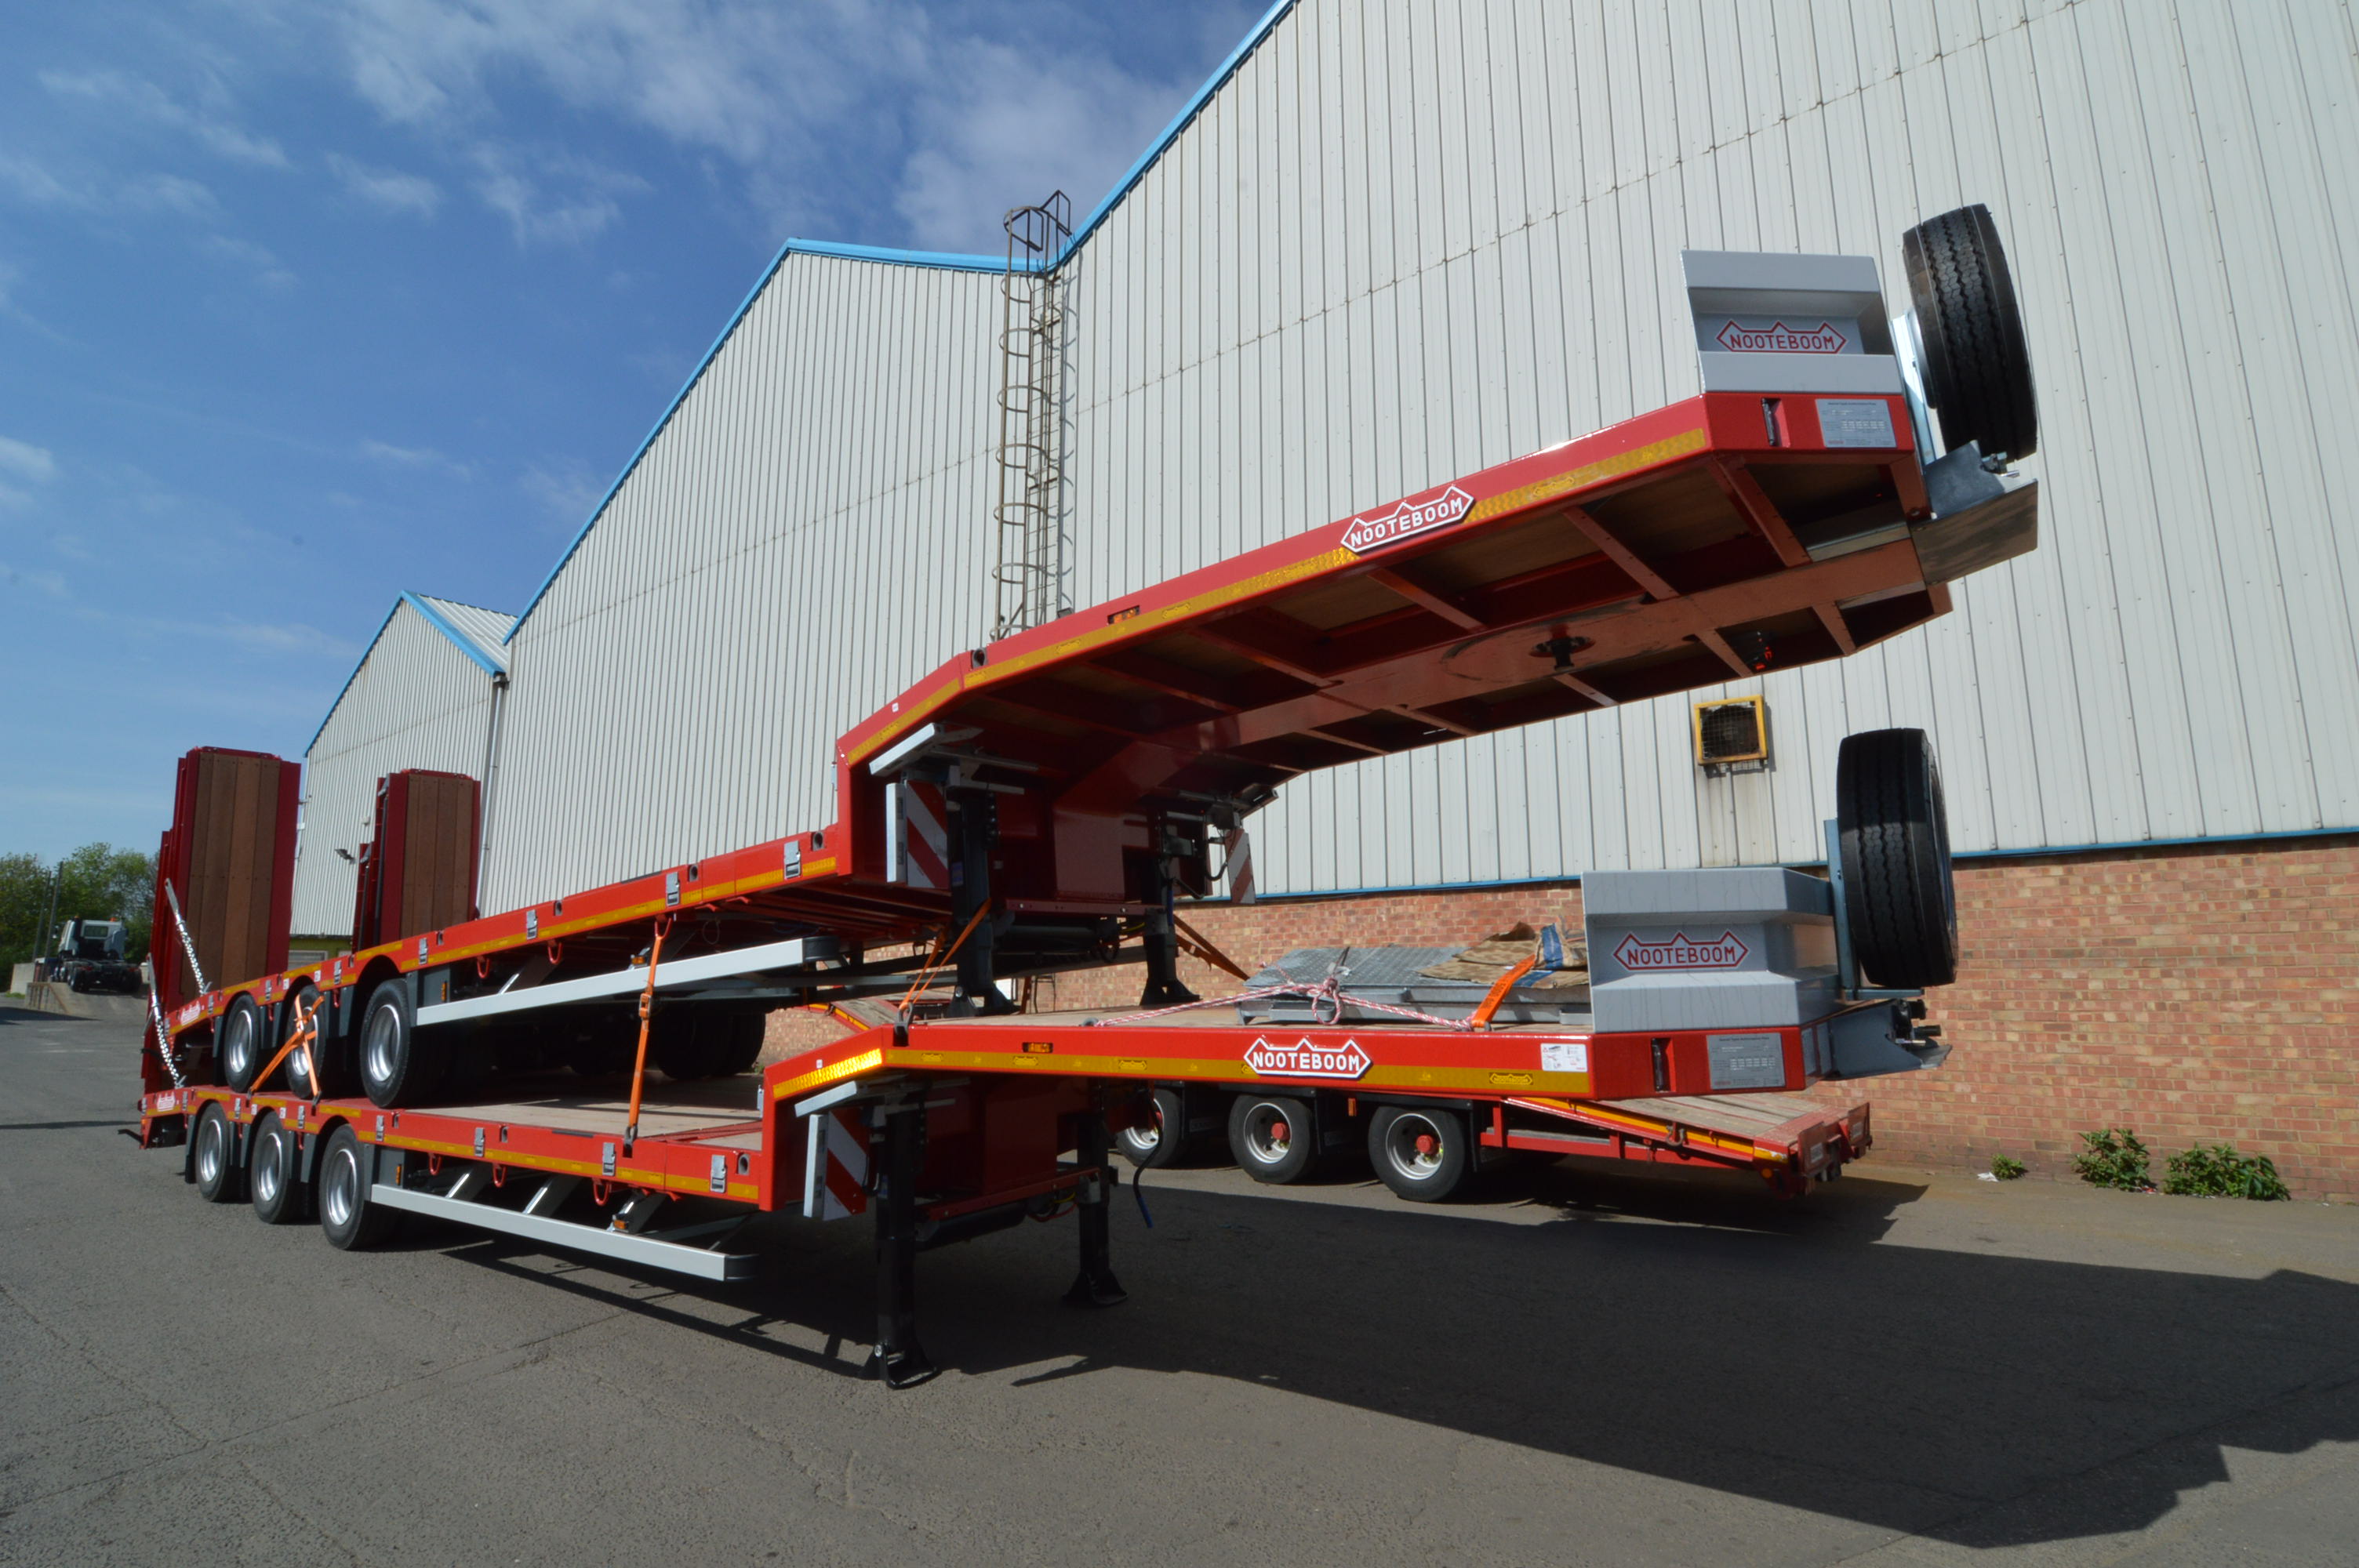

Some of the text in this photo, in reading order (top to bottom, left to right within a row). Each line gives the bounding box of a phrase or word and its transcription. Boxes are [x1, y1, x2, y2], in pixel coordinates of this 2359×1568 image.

[1729, 334, 1836, 350] NOOTEBOOM
[1350, 496, 1463, 547] NOOTEBOOM
[1627, 946, 1736, 965] NOOTEBOOM
[1252, 1051, 1361, 1071] NOOTEBOOM
